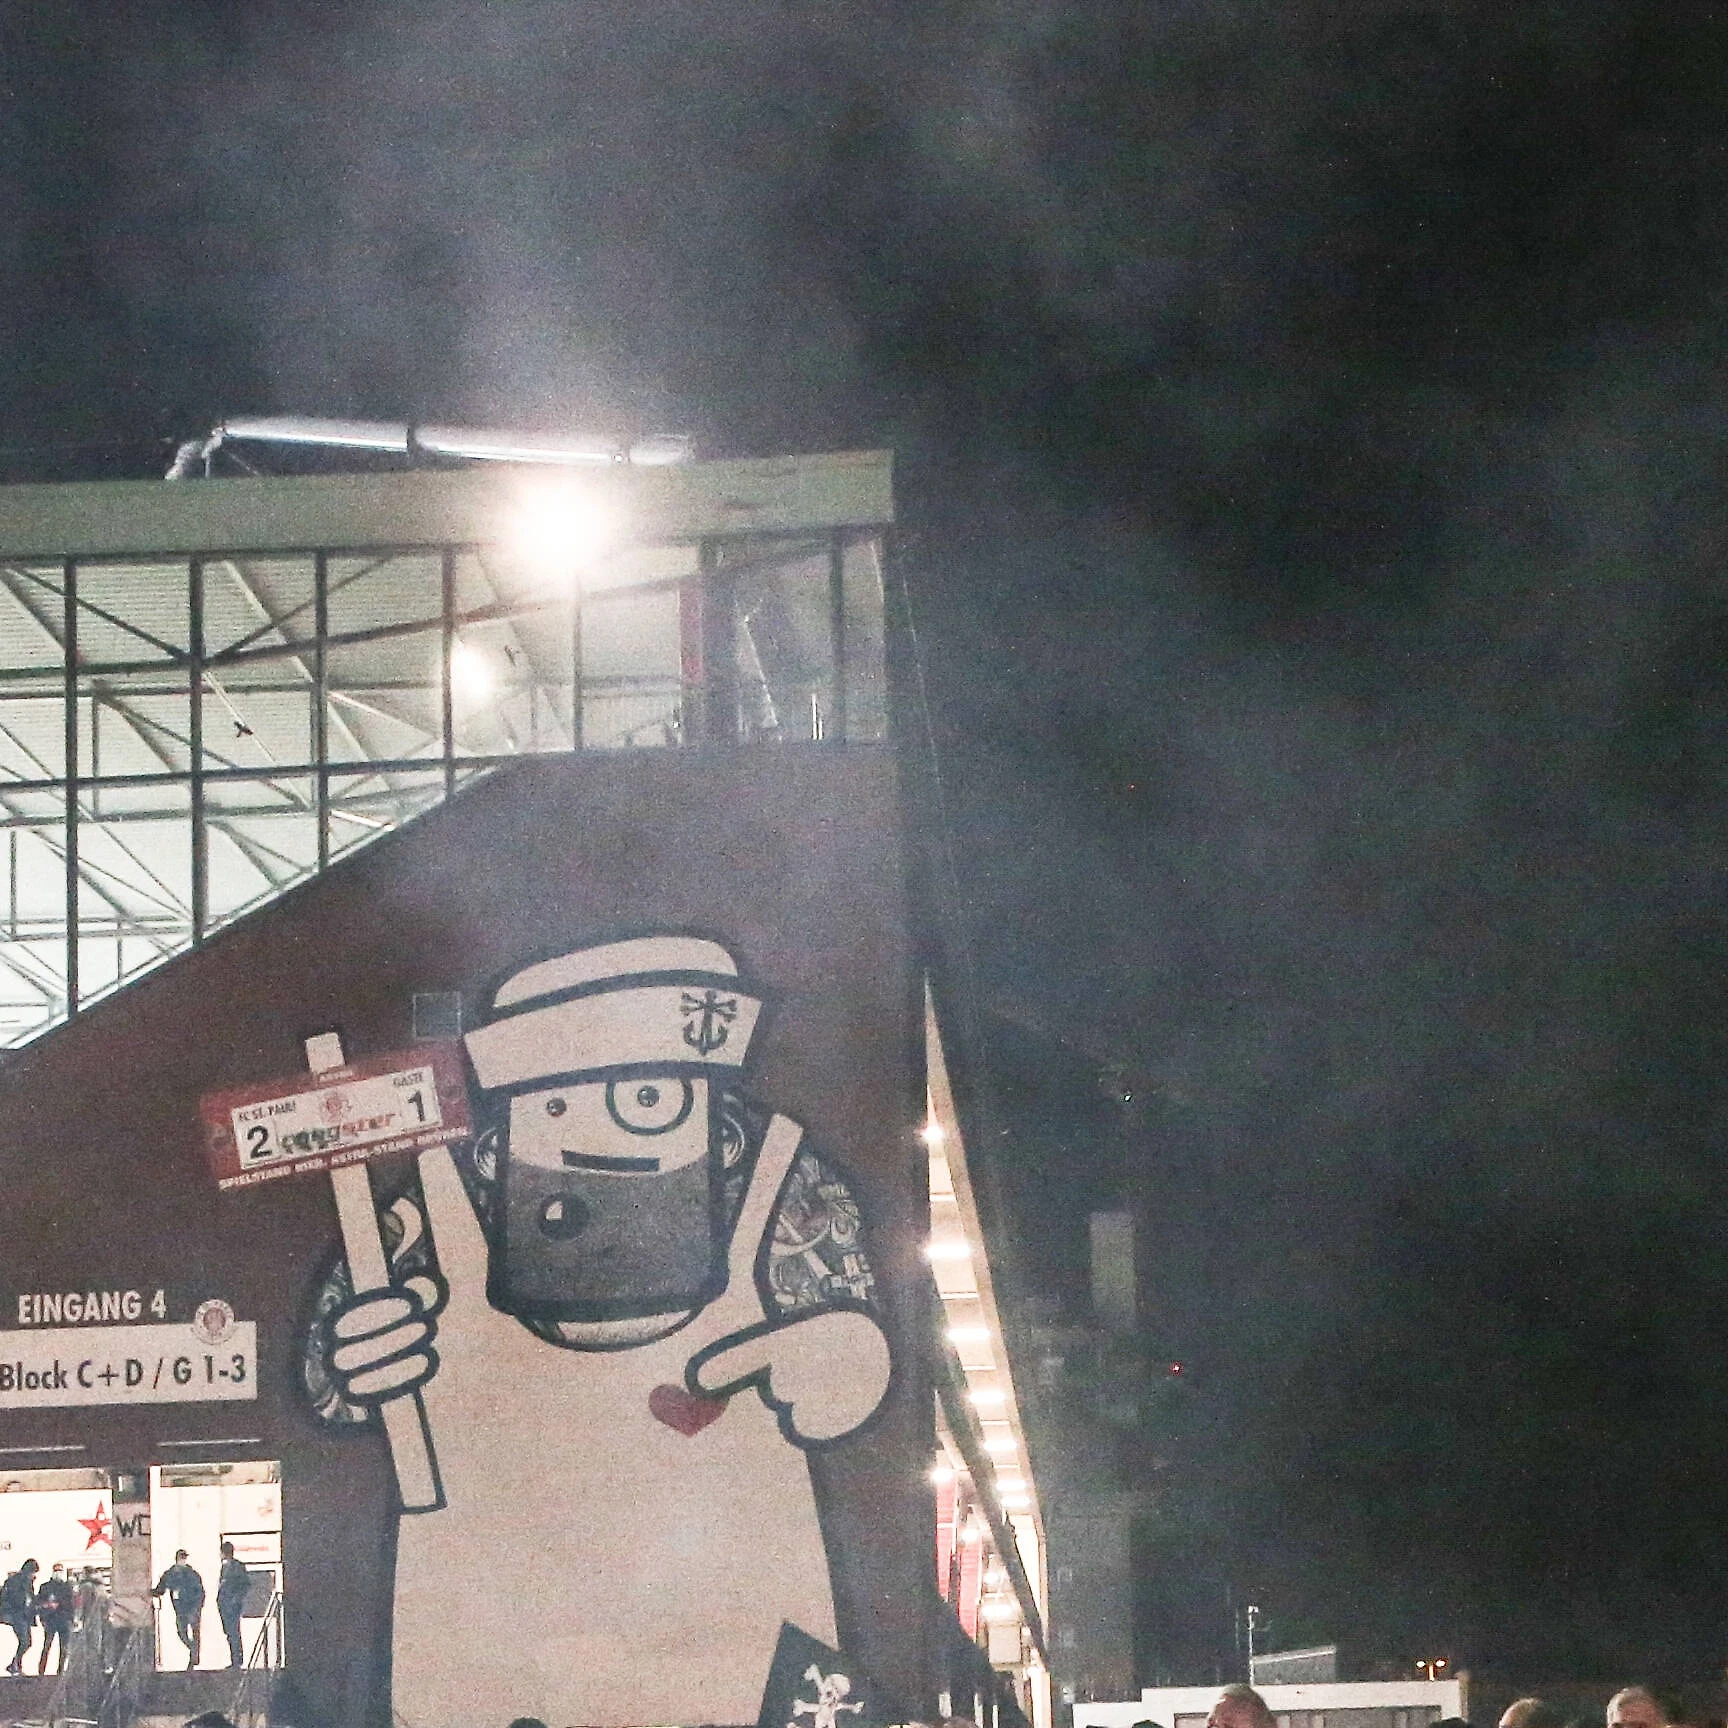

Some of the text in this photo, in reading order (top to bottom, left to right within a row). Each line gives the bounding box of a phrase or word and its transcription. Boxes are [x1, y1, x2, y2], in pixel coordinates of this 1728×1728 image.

[407, 1090, 426, 1122] 1
[247, 1124, 272, 1159] 2
[18, 1289, 167, 1323] EINGANG 4
